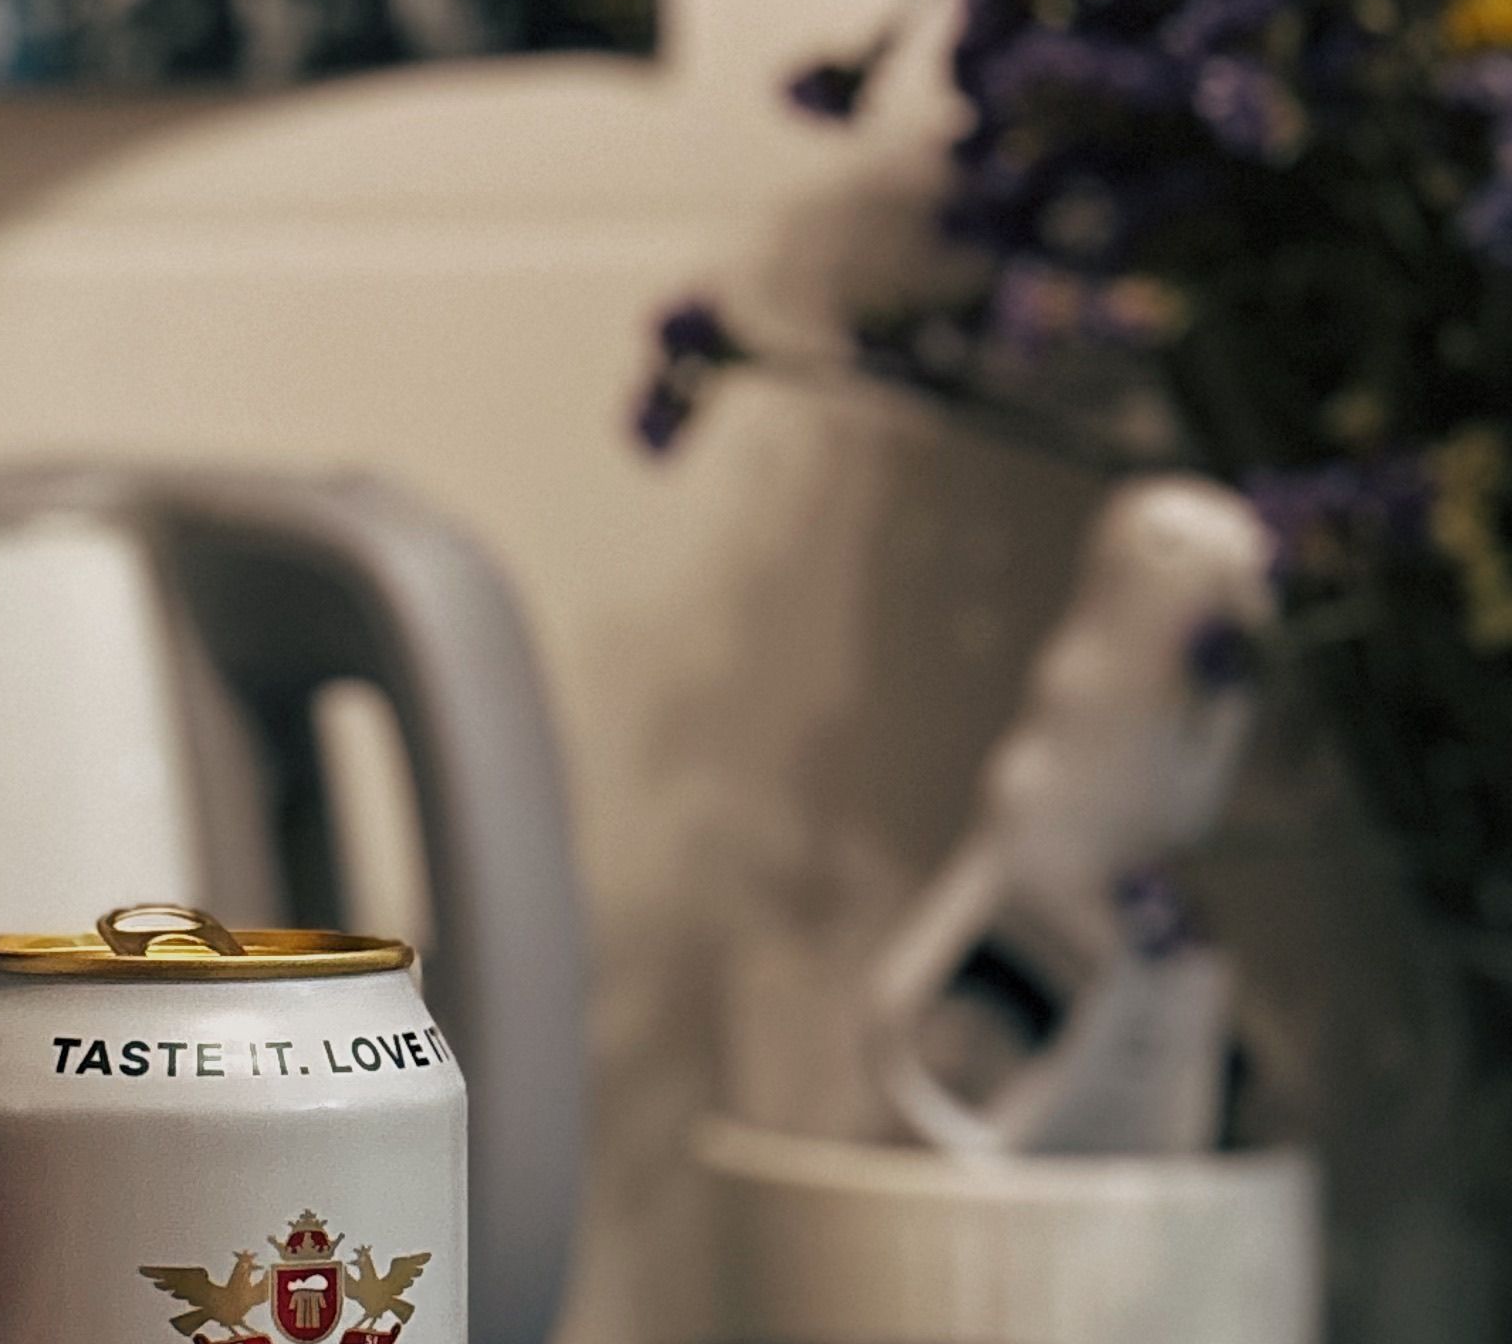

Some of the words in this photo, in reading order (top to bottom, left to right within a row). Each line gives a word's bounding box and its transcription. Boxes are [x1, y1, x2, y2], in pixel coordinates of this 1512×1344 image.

[52, 1037, 226, 1077] TASTE
[249, 1041, 310, 1076] IT.
[322, 1031, 430, 1074] LOVE
